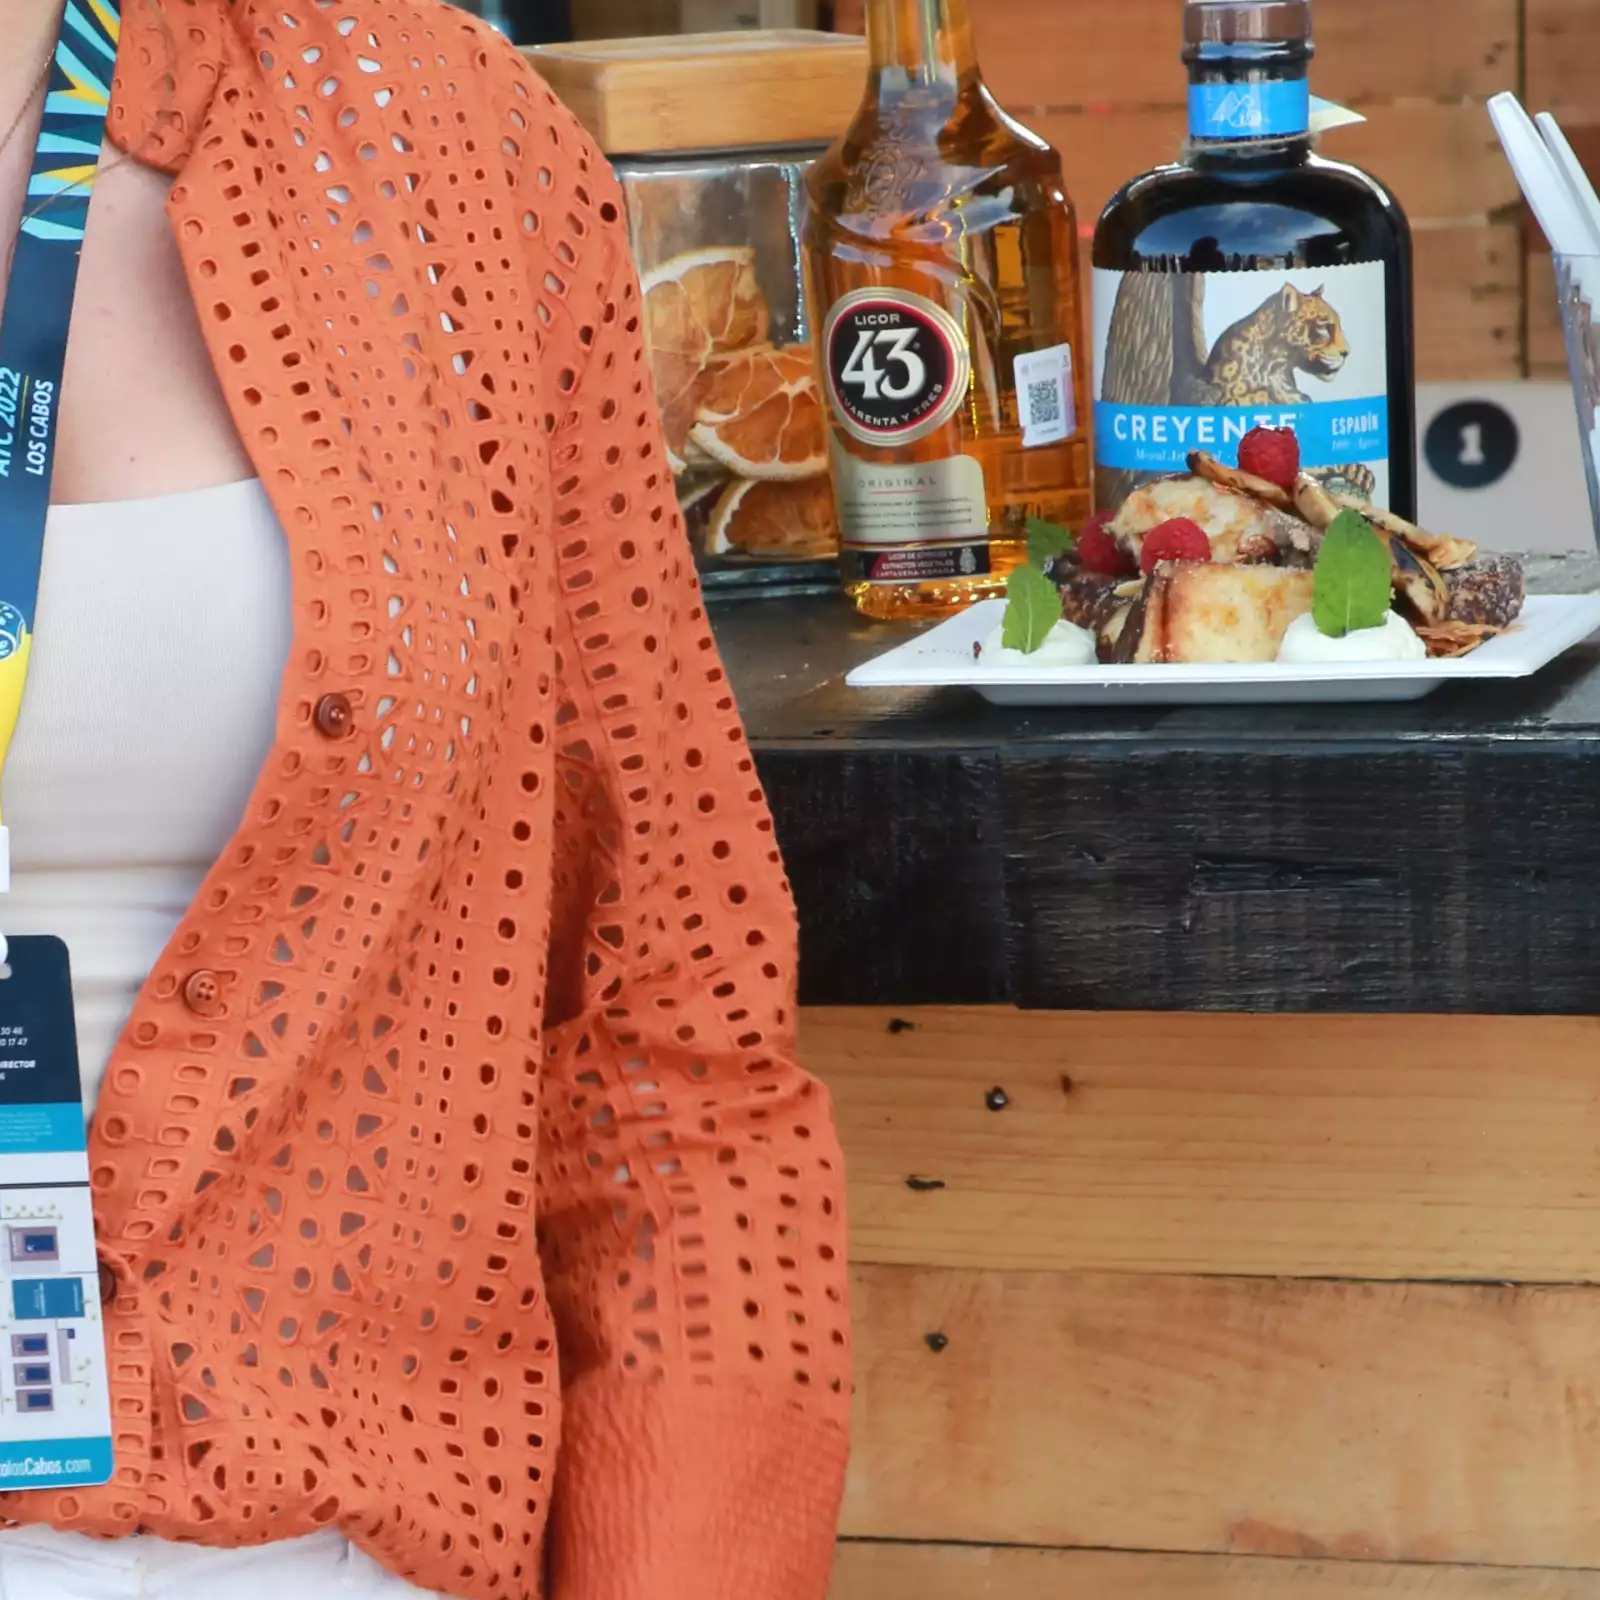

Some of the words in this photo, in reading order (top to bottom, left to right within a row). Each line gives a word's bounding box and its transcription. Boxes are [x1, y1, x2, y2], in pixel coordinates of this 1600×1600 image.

[854, 313, 901, 325] LICOR
[841, 327, 926, 399] 43
[29, 379, 54, 438] CABOS
[901, 413, 910, 422] Y
[913, 382, 943, 417] TRES
[25, 439, 47, 475] LOS
[1458, 421, 1485, 465] 1
[858, 476, 937, 488] ORIGINAL
